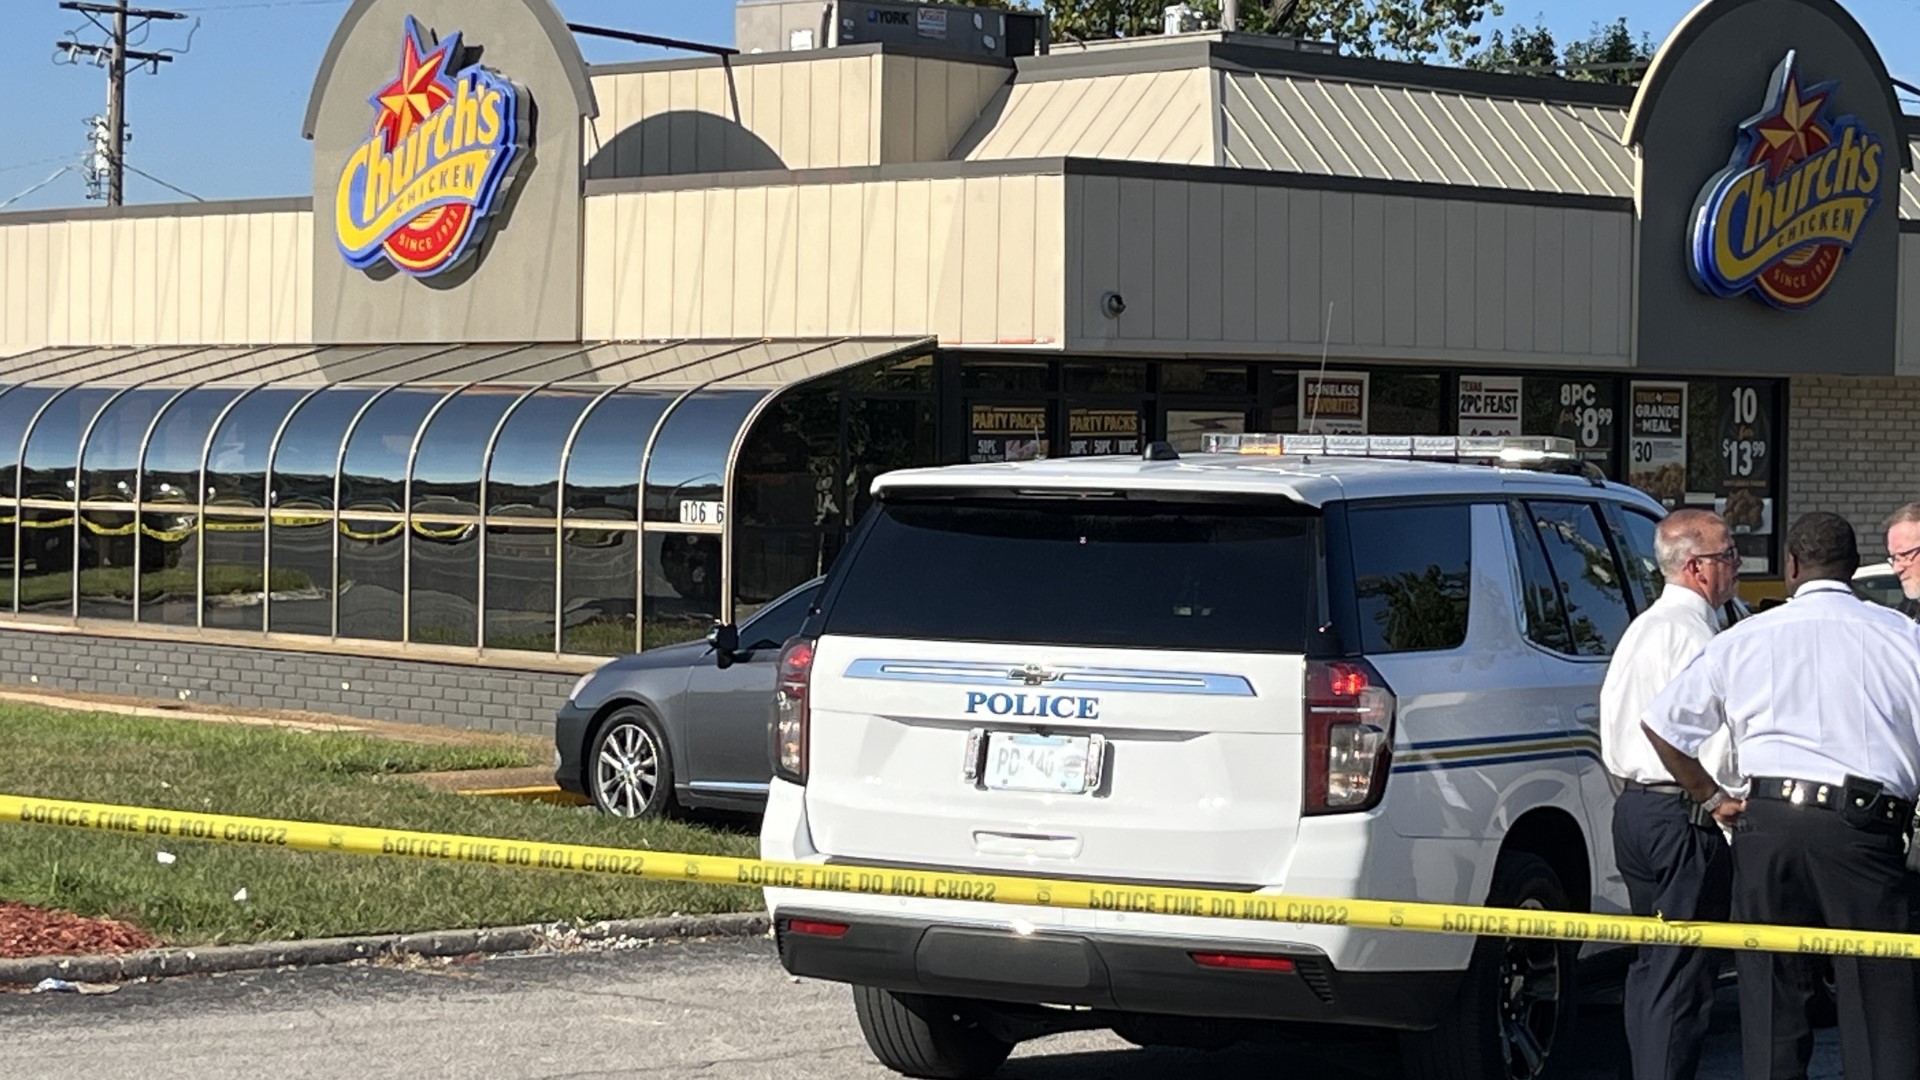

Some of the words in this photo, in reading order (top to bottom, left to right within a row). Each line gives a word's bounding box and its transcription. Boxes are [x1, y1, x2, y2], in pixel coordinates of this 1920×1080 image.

[878, 11, 910, 25] YORK
[336, 79, 500, 251] Church's
[397, 163, 476, 214] CHICKEN
[1715, 127, 1881, 281] Church's
[1777, 208, 1855, 249] CHICKEN
[398, 232, 433, 252] SINCE
[1773, 268, 1807, 289] SINCE
[1307, 383, 1360, 397] BONELESS
[1560, 383, 1596, 406] 8PC
[1460, 394, 1482, 414] 2PC
[1484, 395, 1518, 414] FEAST
[1635, 404, 1680, 418] GRANDE
[1732, 387, 1758, 424] 10
[972, 412, 1008, 429] PARTY
[1009, 412, 1046, 429] PACKS
[1069, 415, 1103, 432] PARTY
[1104, 415, 1138, 432] PACKS
[1642, 419, 1672, 433] MEAL
[683, 501, 706, 523] 106
[964, 691, 1099, 720] POLICE
[996, 747, 1021, 776] PD
